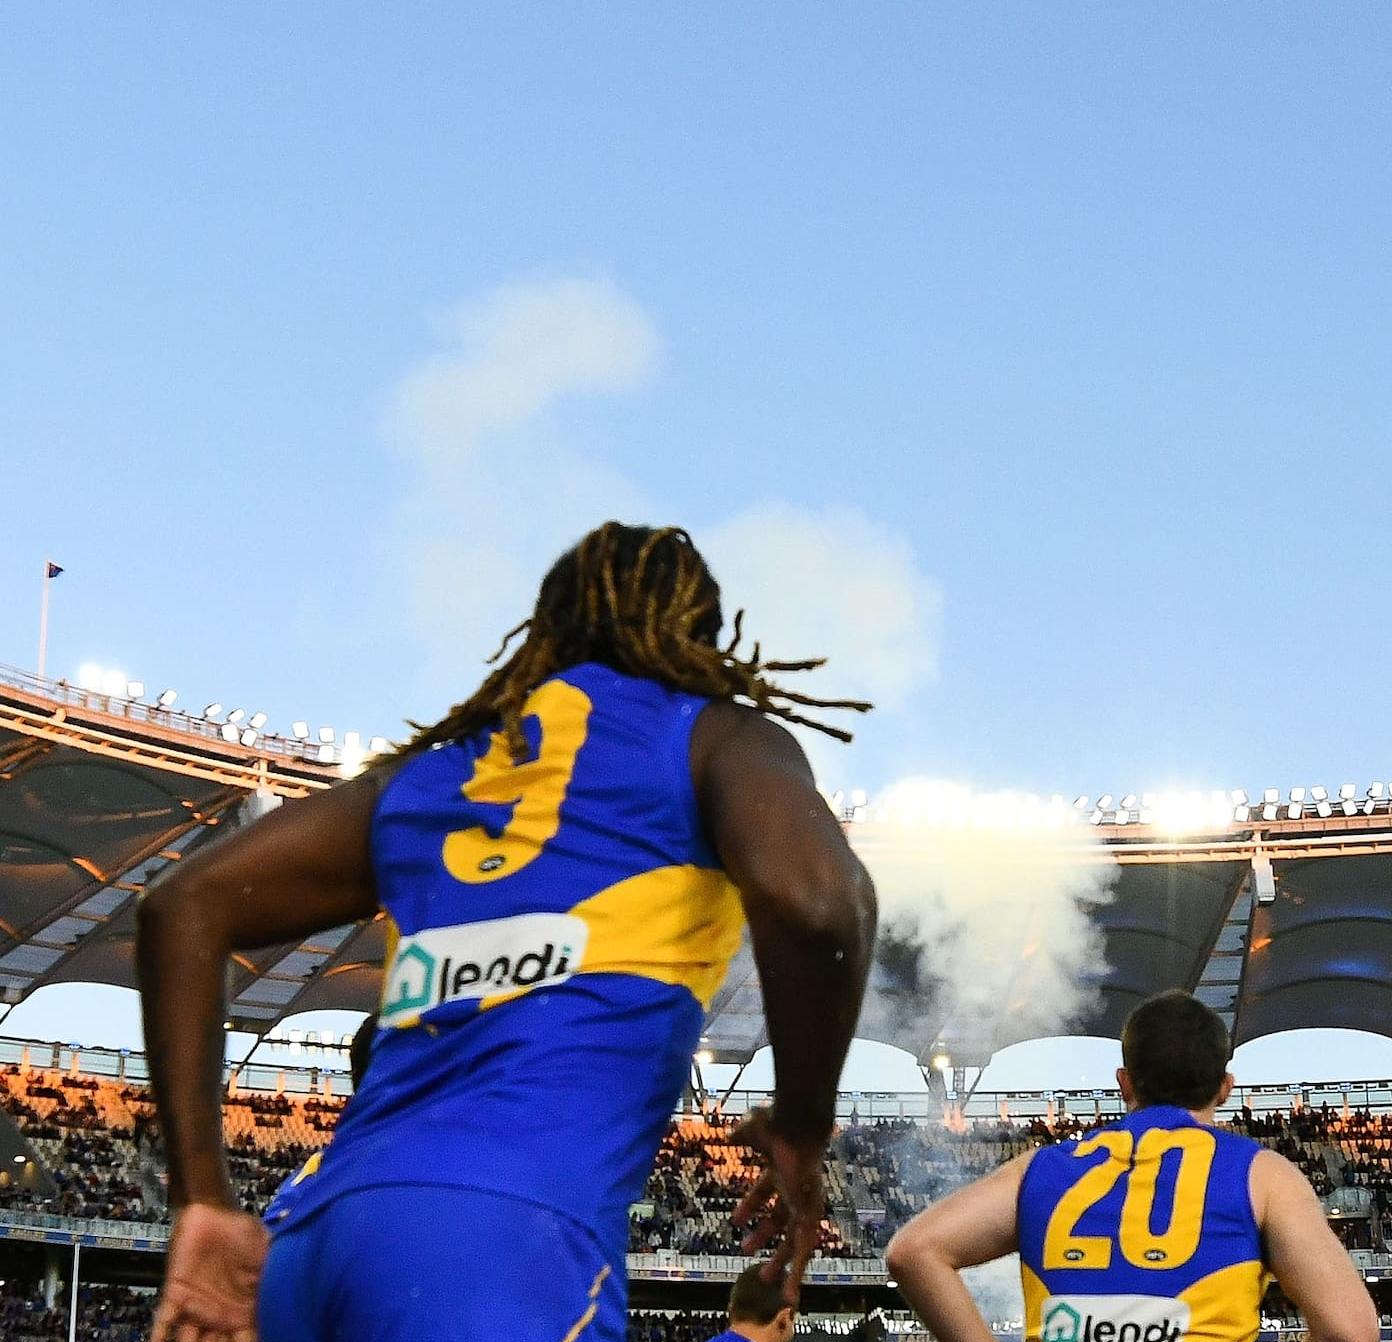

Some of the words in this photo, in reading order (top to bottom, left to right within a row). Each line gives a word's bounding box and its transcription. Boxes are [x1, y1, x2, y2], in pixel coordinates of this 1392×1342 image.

[442, 679, 593, 884] 9
[440, 944, 572, 1002] lendi
[1043, 1127, 1217, 1270] 20
